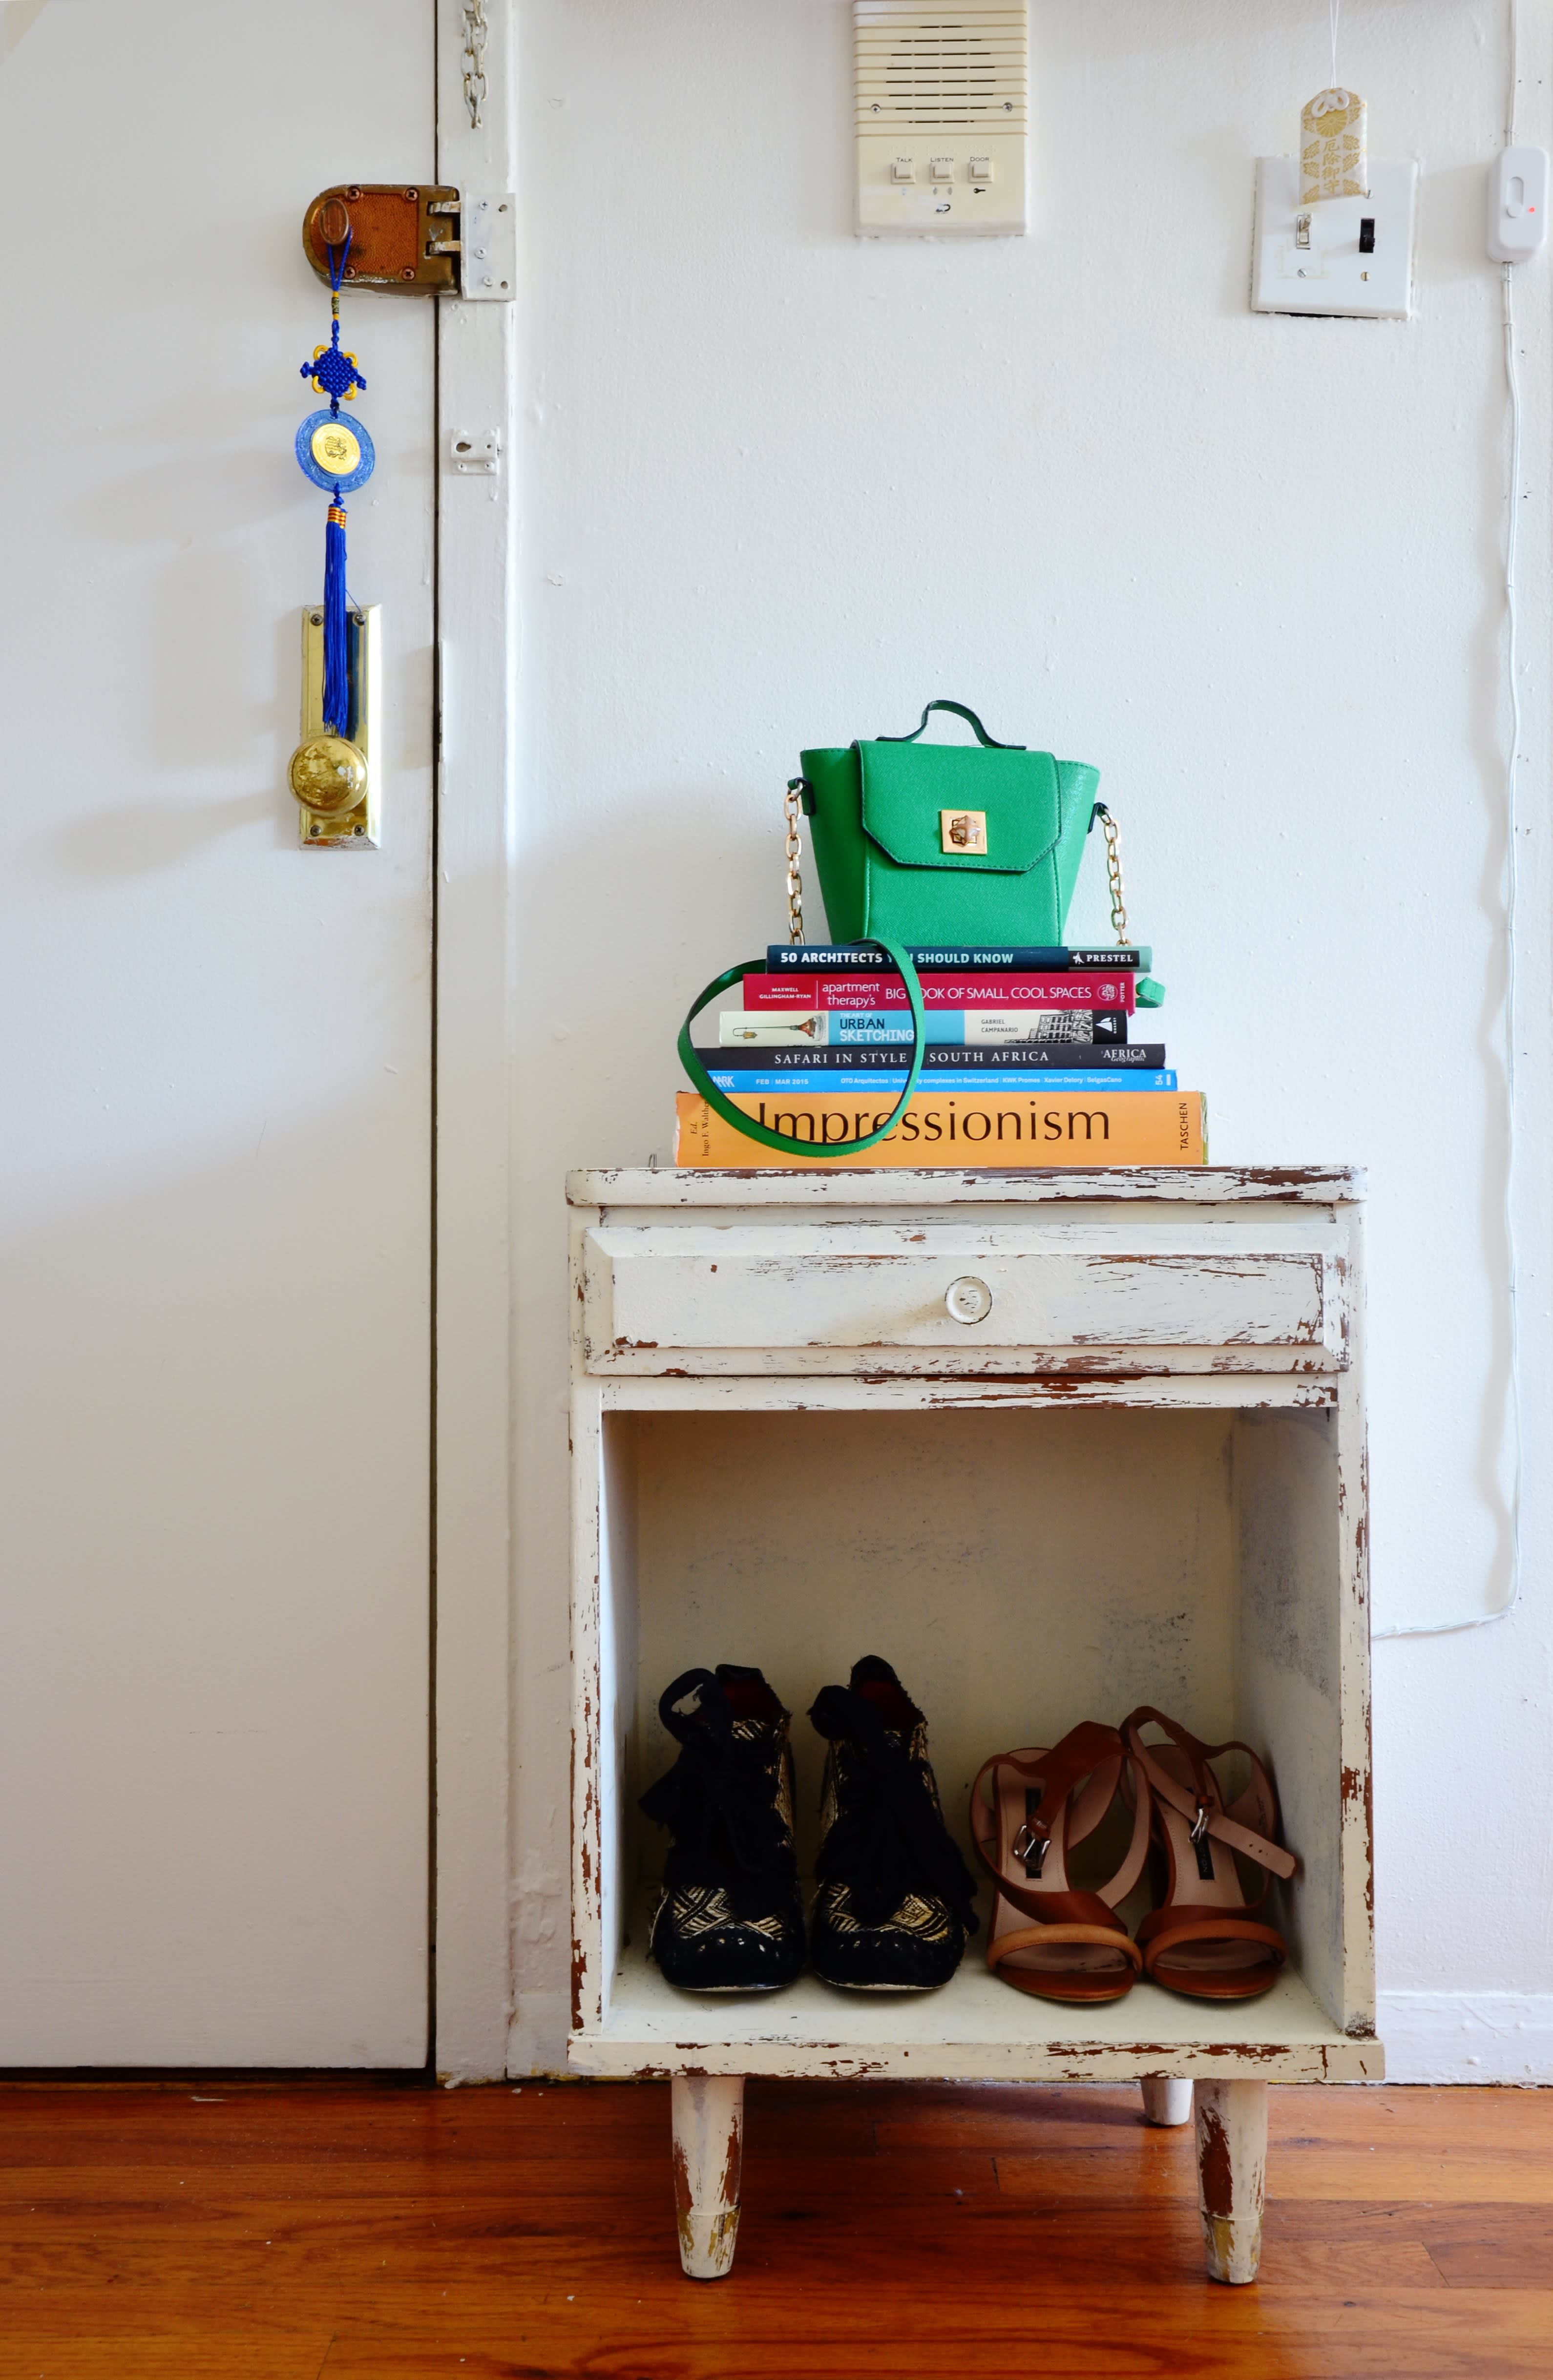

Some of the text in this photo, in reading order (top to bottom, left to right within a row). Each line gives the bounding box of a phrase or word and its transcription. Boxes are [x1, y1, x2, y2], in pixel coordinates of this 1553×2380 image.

[1322, 138, 1341, 194] 厄除御守
[781, 953, 797, 963] 50
[801, 953, 882, 963] ARCHITECTS
[918, 953, 969, 963] SHOULD
[973, 953, 1013, 963] KNOW
[822, 983, 880, 994] apartment
[886, 987, 1092, 1000] BIG OOK OF SMALL, COOL SPACES
[827, 995, 876, 1008] therapy's
[840, 1019, 885, 1029] URBAN
[839, 1029, 915, 1042] SKETCHING
[775, 1052, 1049, 1064] SAFARI IN STYLE SOUTH AFRICA
[1103, 1049, 1147, 1058] AFRICA
[758, 1101, 1110, 1143] Impressionism
[1179, 1103, 1189, 1150] TASCHEN
[702, 1140, 711, 1156] Ingo
